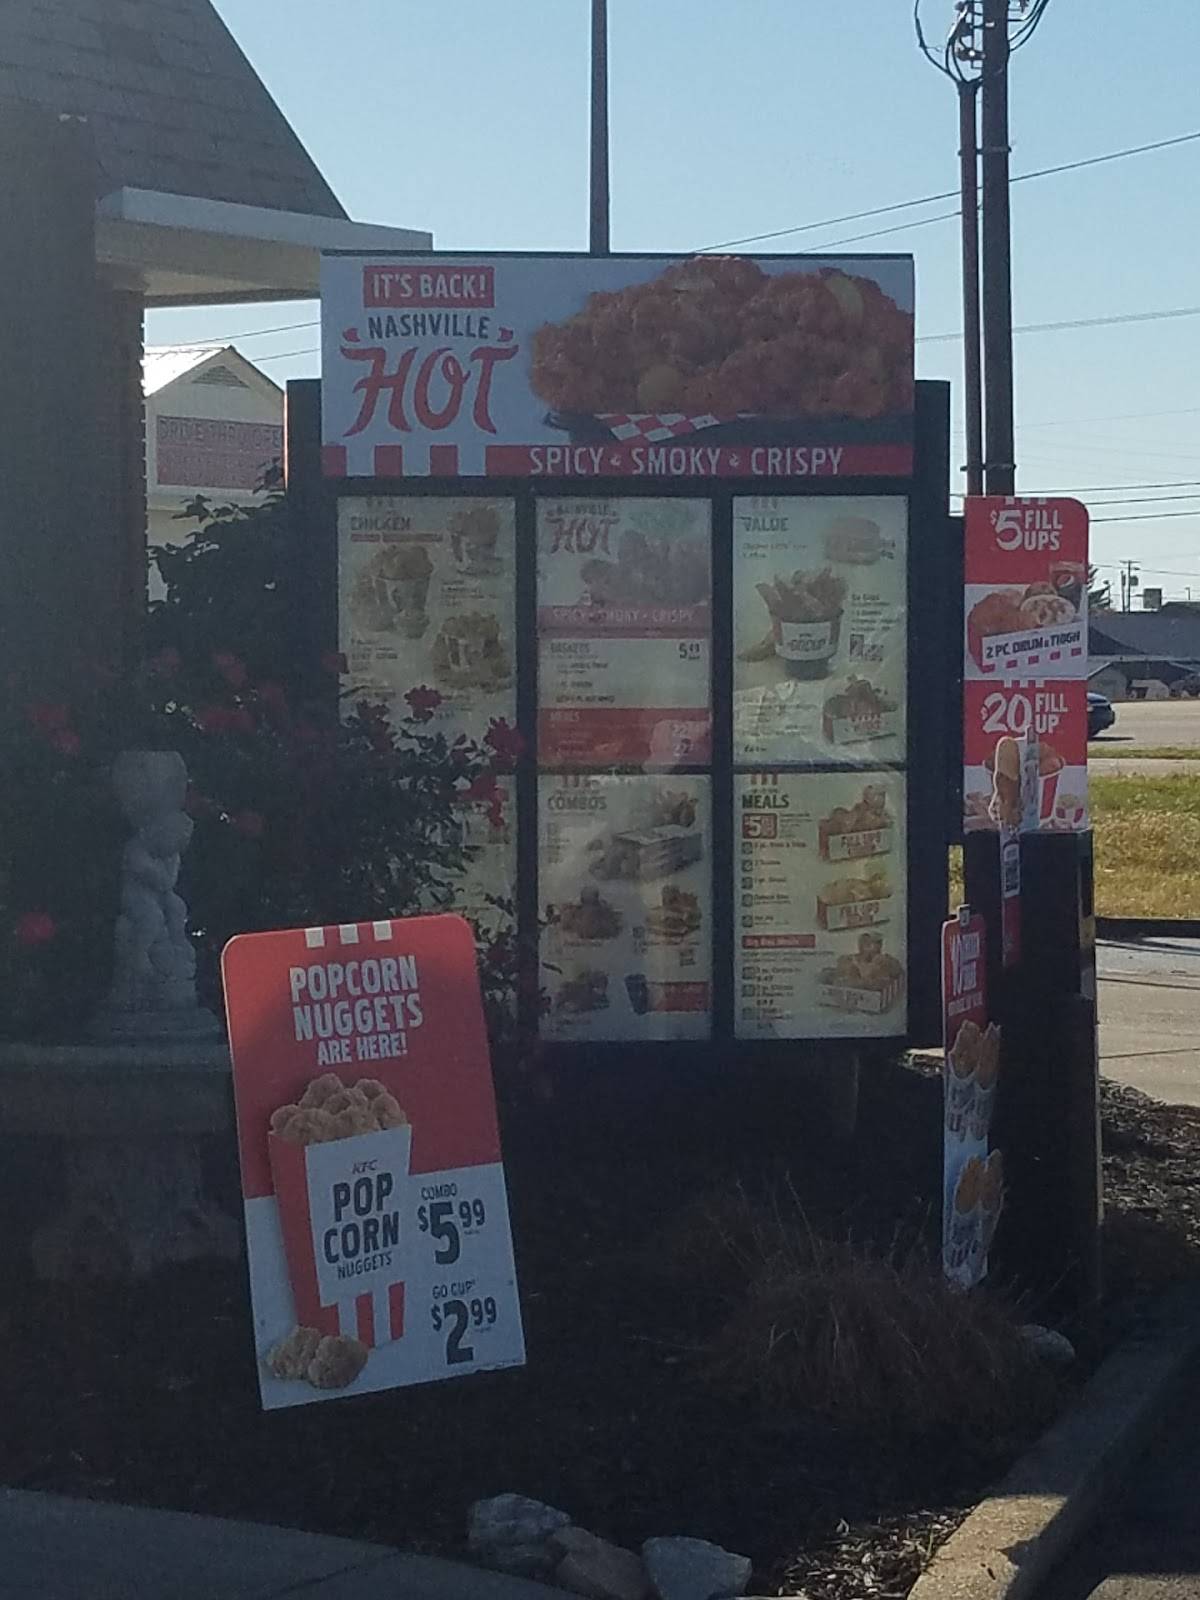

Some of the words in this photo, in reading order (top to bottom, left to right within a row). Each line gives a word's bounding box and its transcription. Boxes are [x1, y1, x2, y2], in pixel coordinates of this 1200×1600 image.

[373, 273, 413, 299] IT'S
[419, 273, 487, 299] BACK!
[367, 313, 491, 340] NASHVILLE
[339, 344, 520, 438] HOT
[529, 446, 604, 476] SPICY
[630, 446, 721, 476] SMOKY
[750, 446, 844, 476] CRISPY
[1023, 508, 1064, 531] FILL
[1022, 529, 1061, 551] UPS
[995, 642, 1011, 657] PC
[1034, 692, 1068, 714] FILL
[1034, 712, 1059, 734] UP
[742, 795, 790, 810] MEALS
[289, 955, 418, 1002] POPCORN
[293, 993, 423, 1041] NUGGETS
[317, 1034, 353, 1066] ARE
[356, 1032, 408, 1061] HERE!
[352, 1159, 378, 1174] KFC
[333, 1172, 393, 1222] POP
[421, 1182, 458, 1201] COMBO
[324, 1211, 399, 1264] CORN
[337, 1251, 393, 1281] NUGGETS
[432, 1284, 449, 1300] GO
